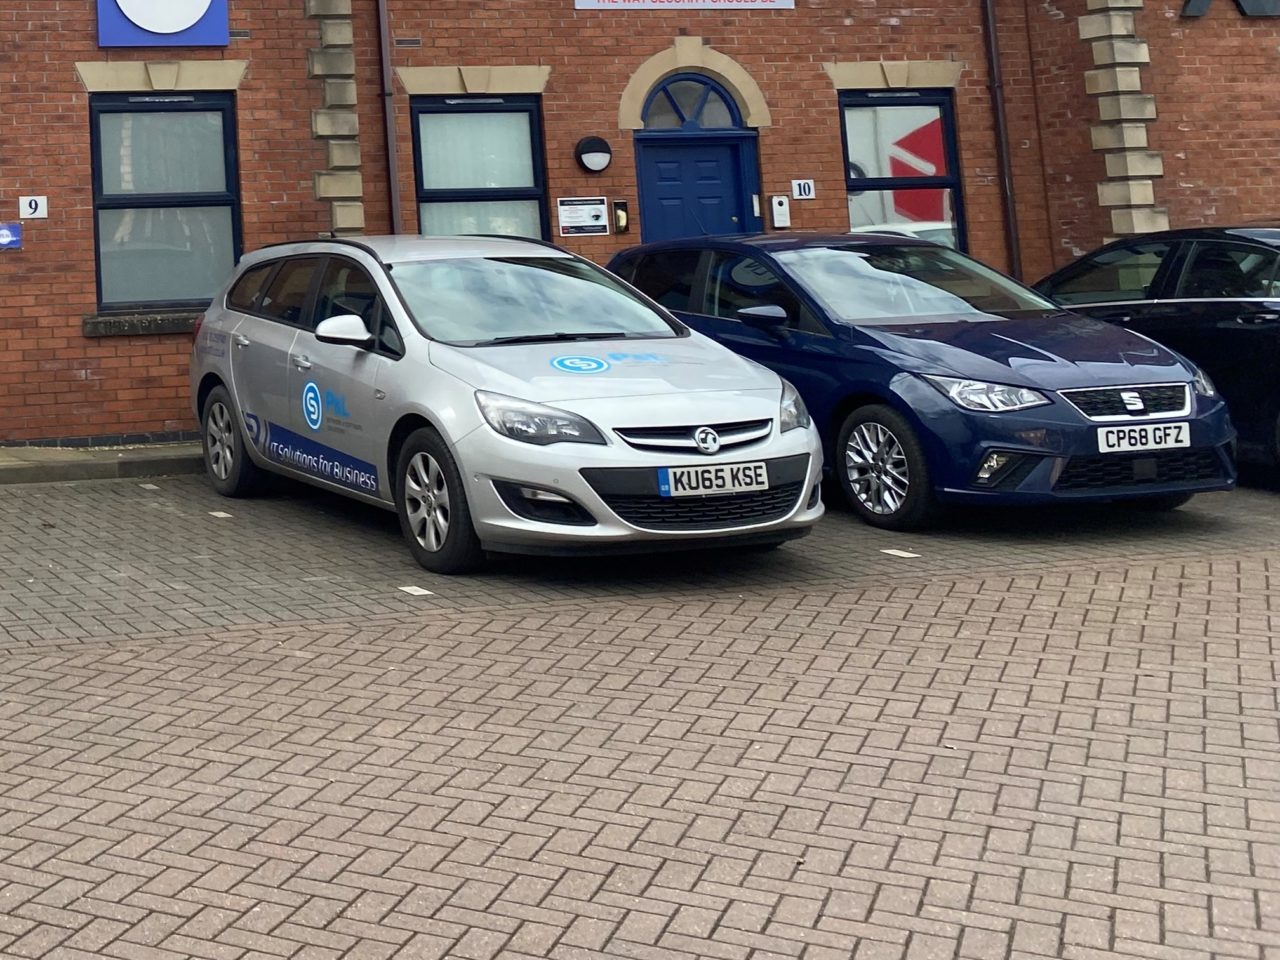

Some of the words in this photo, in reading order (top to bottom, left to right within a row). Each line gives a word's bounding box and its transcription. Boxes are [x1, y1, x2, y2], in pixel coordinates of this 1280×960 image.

[797, 182, 811, 197] 10
[28, 198, 39, 216] 9
[1105, 428, 1149, 448] CP68
[1153, 425, 1183, 445] GFZ
[672, 469, 726, 491] KU65
[730, 465, 765, 488] KSE
